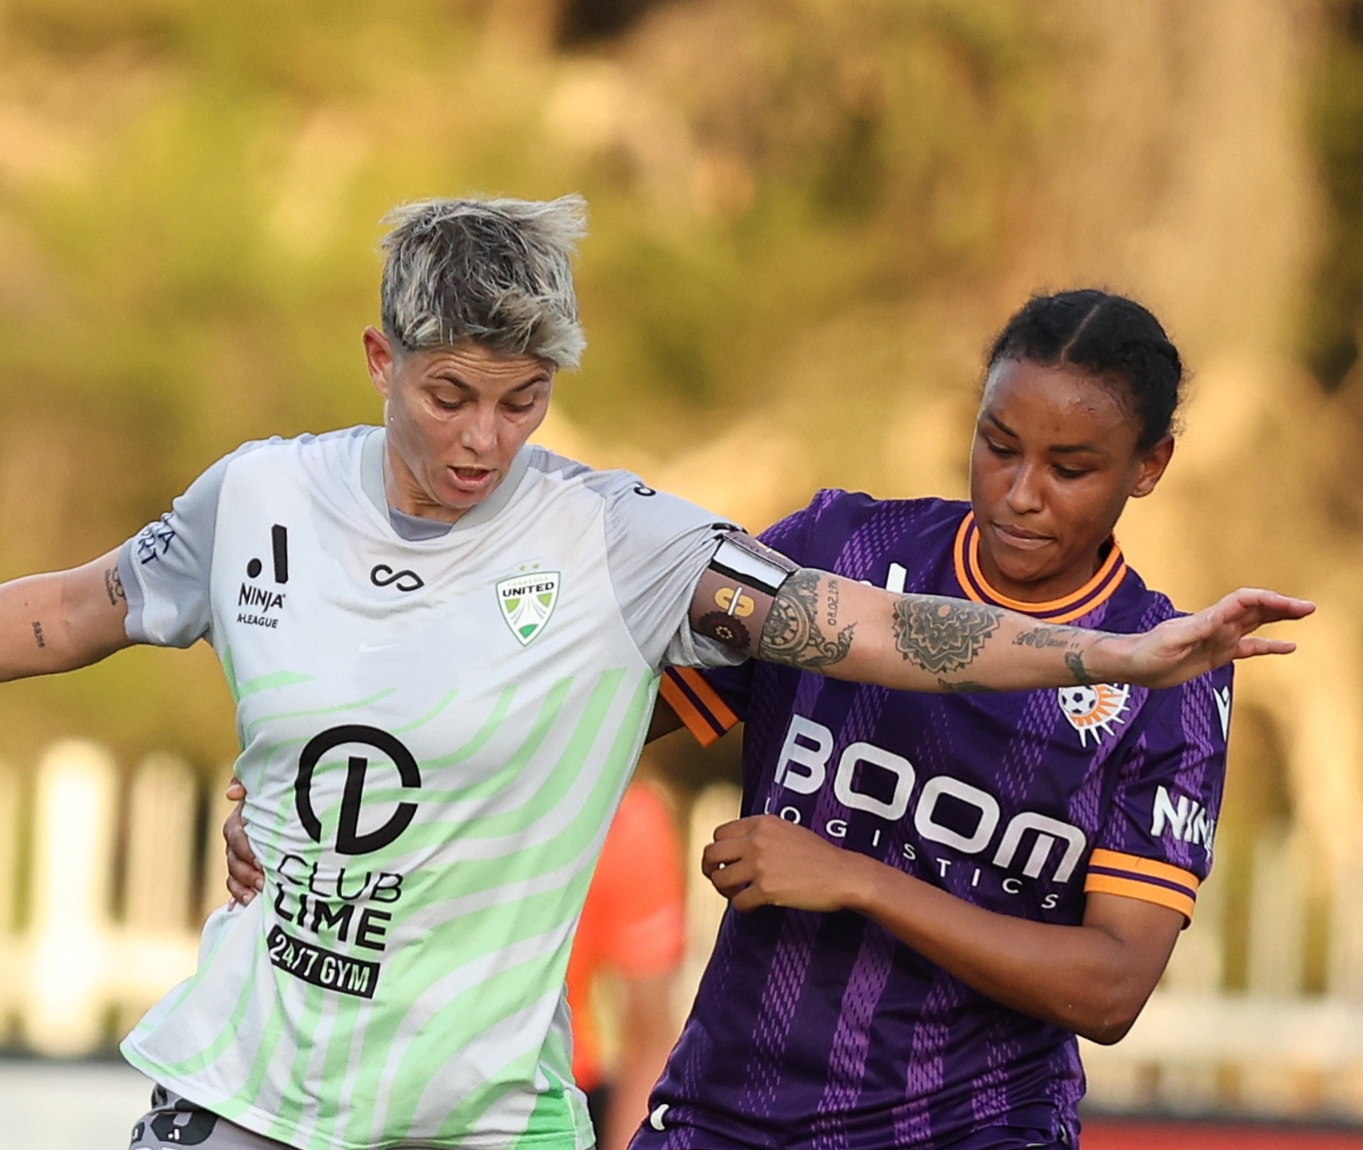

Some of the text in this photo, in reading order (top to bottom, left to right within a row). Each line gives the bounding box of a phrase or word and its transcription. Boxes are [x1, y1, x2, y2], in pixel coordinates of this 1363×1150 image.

[238, 582, 284, 613] NINJA
[502, 581, 555, 597] UNITED
[236, 613, 278, 628] A-LEAGUE
[774, 713, 1087, 883] BOOM
[1151, 784, 1215, 863] NIN
[277, 854, 403, 903] CLUB
[274, 882, 392, 951] LIME
[269, 933, 371, 993] 24/7 GYM
